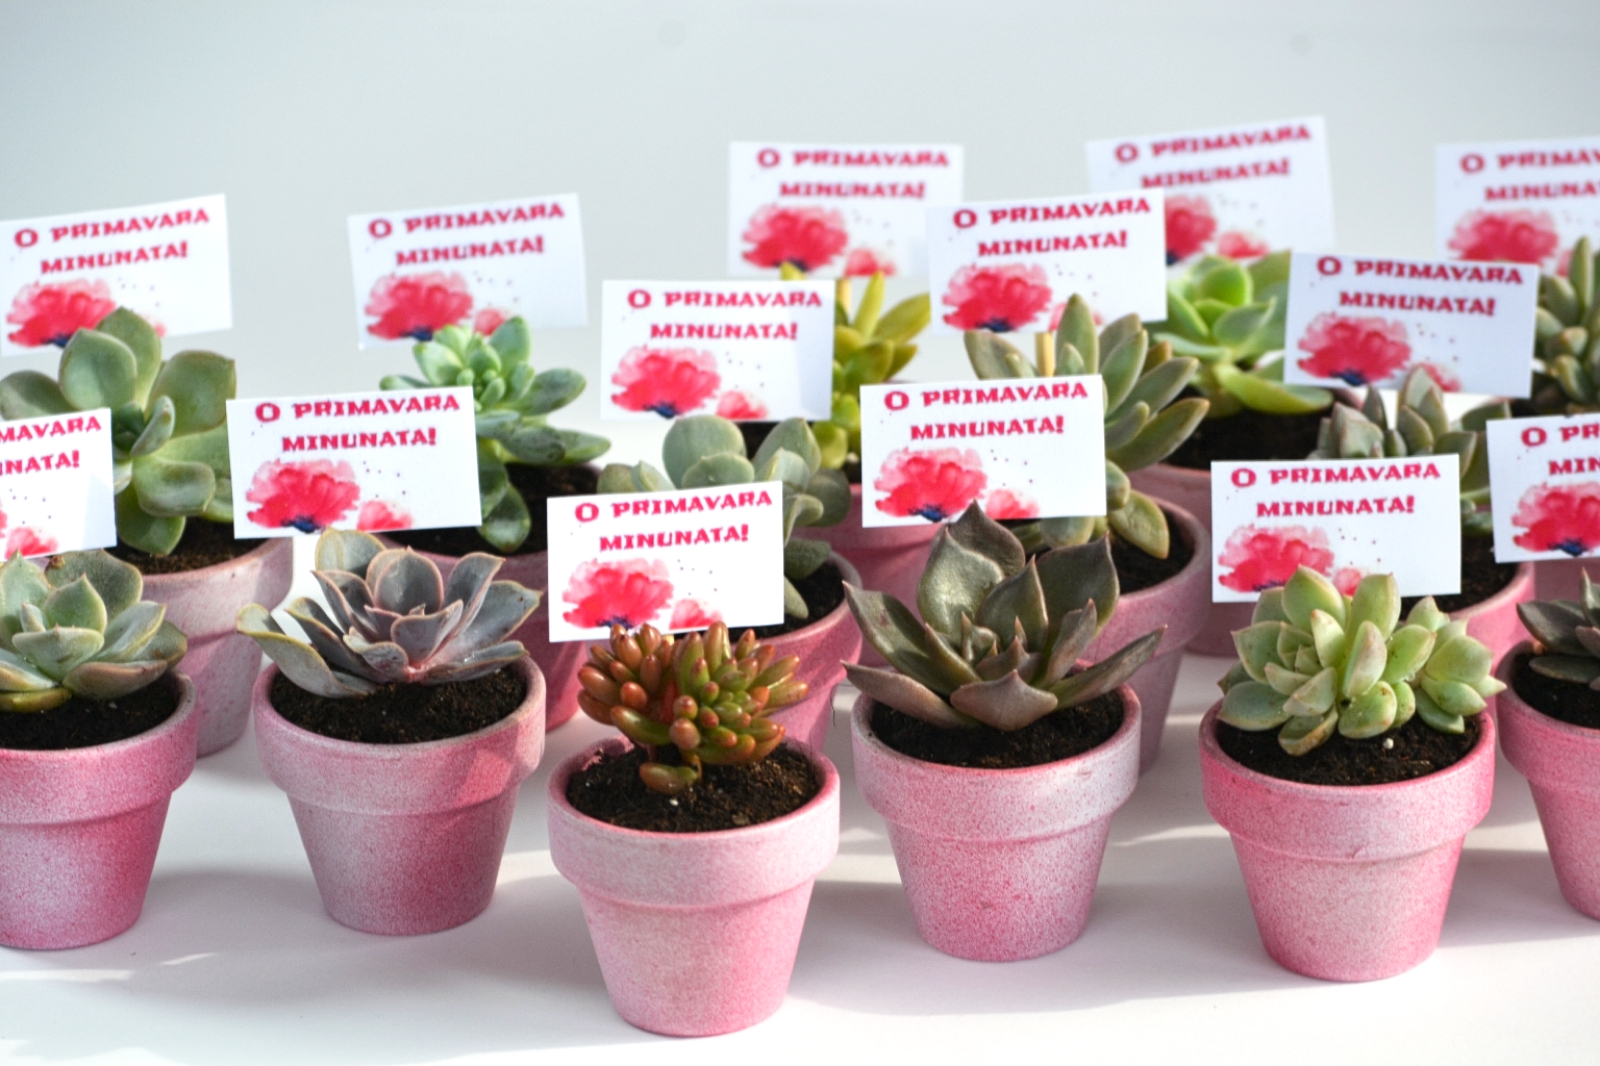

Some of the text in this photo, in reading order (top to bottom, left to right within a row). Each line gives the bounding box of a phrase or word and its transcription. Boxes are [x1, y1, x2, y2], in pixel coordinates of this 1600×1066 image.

[1114, 125, 1311, 164] O PRIMAVARA
[756, 149, 948, 168] O PRIMAVARA
[1459, 153, 1486, 174] O
[1141, 158, 1290, 189] MINUNATA!
[779, 182, 926, 199] MINUNATA!
[1484, 181, 1600, 202] MINUNA
[368, 203, 564, 239] O PRIMAVARA
[952, 197, 1151, 229] O PRIMAVARA
[13, 208, 209, 249] O PRIMAVARA
[396, 235, 544, 266] MINUNATA!
[978, 229, 1128, 257] MINUNATA!
[40, 240, 188, 274] MINUNATA!
[1316, 256, 1523, 284] O PRIMAVARA
[627, 289, 822, 309] O PRIMAVARA
[1339, 291, 1496, 317] MINUNATA!
[650, 323, 798, 340] MINUNATA!
[254, 394, 460, 423] O PRIMAVARA
[883, 382, 1088, 411] O PRIMAVARA
[282, 427, 437, 452] MINUNATA!
[910, 415, 1065, 440] MINUNATA!
[1520, 426, 1548, 448] O
[0, 449, 80, 476] NATA!
[1230, 462, 1440, 488] O PRIMAVARA
[574, 490, 773, 523] O PRIMAVARA
[1256, 495, 1415, 517] MINUNATA!
[599, 523, 749, 552] MINUNATA!
